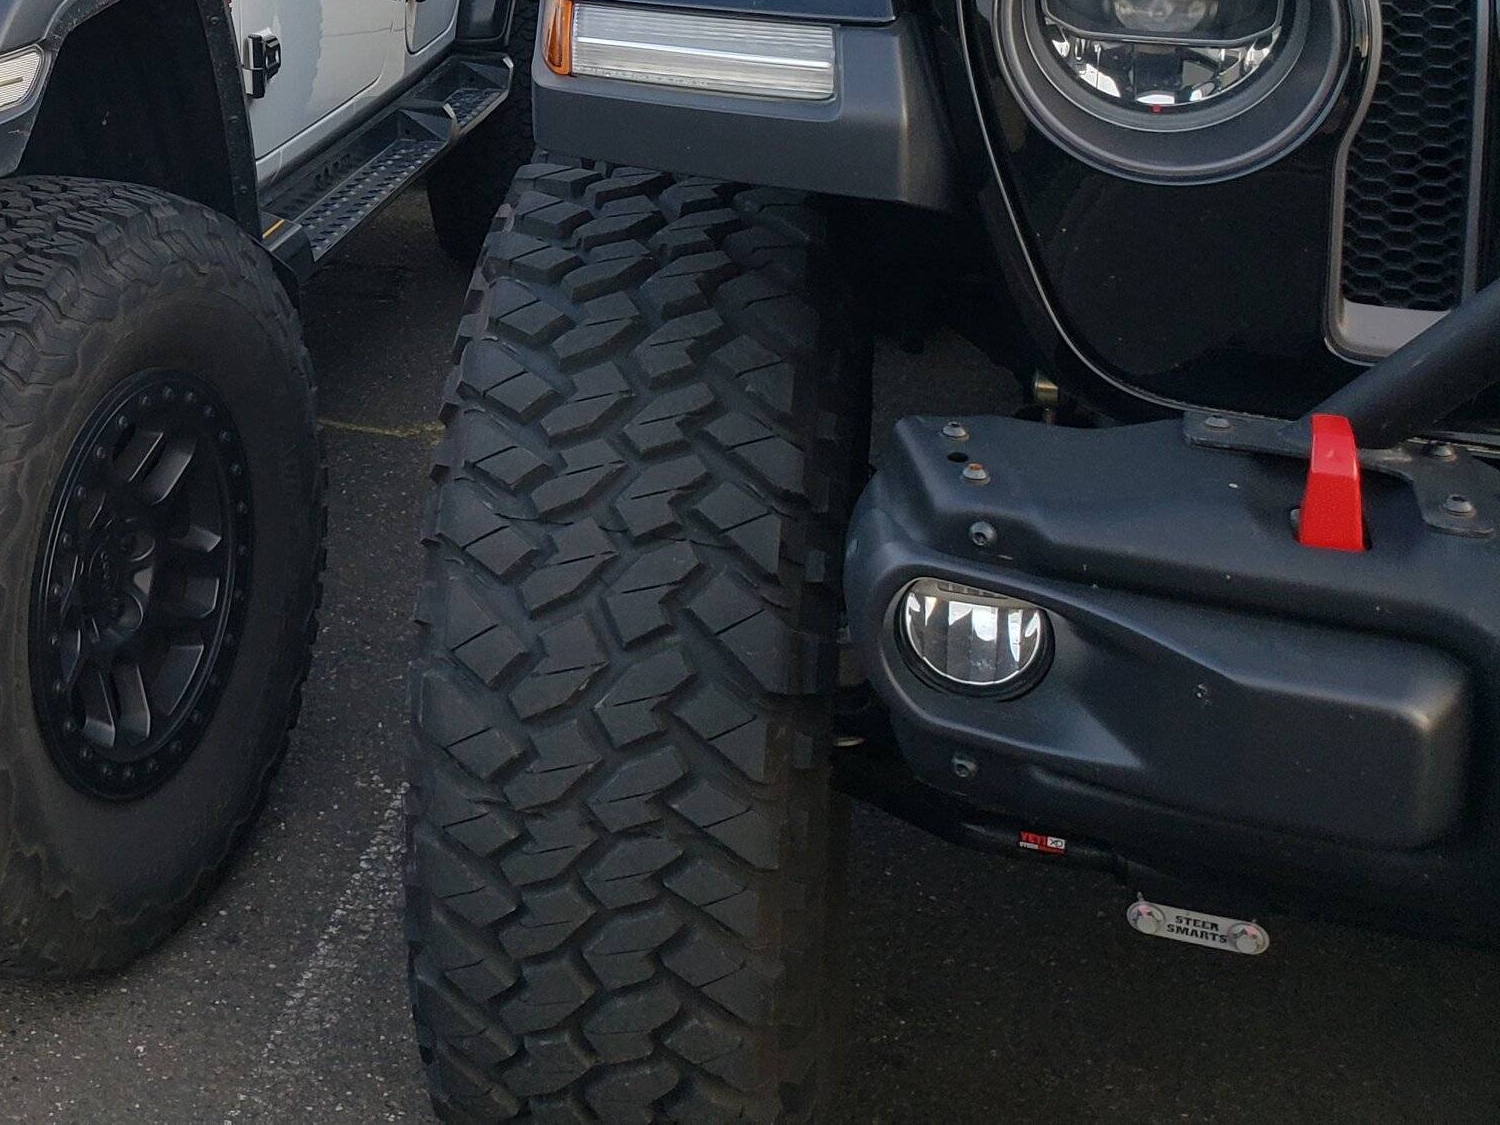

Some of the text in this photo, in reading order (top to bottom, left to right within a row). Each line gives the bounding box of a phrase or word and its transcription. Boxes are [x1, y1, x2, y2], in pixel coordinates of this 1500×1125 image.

[1020, 831, 1046, 845] YETI
[1175, 915, 1219, 931] STEER
[1167, 924, 1228, 943] SMARTS
